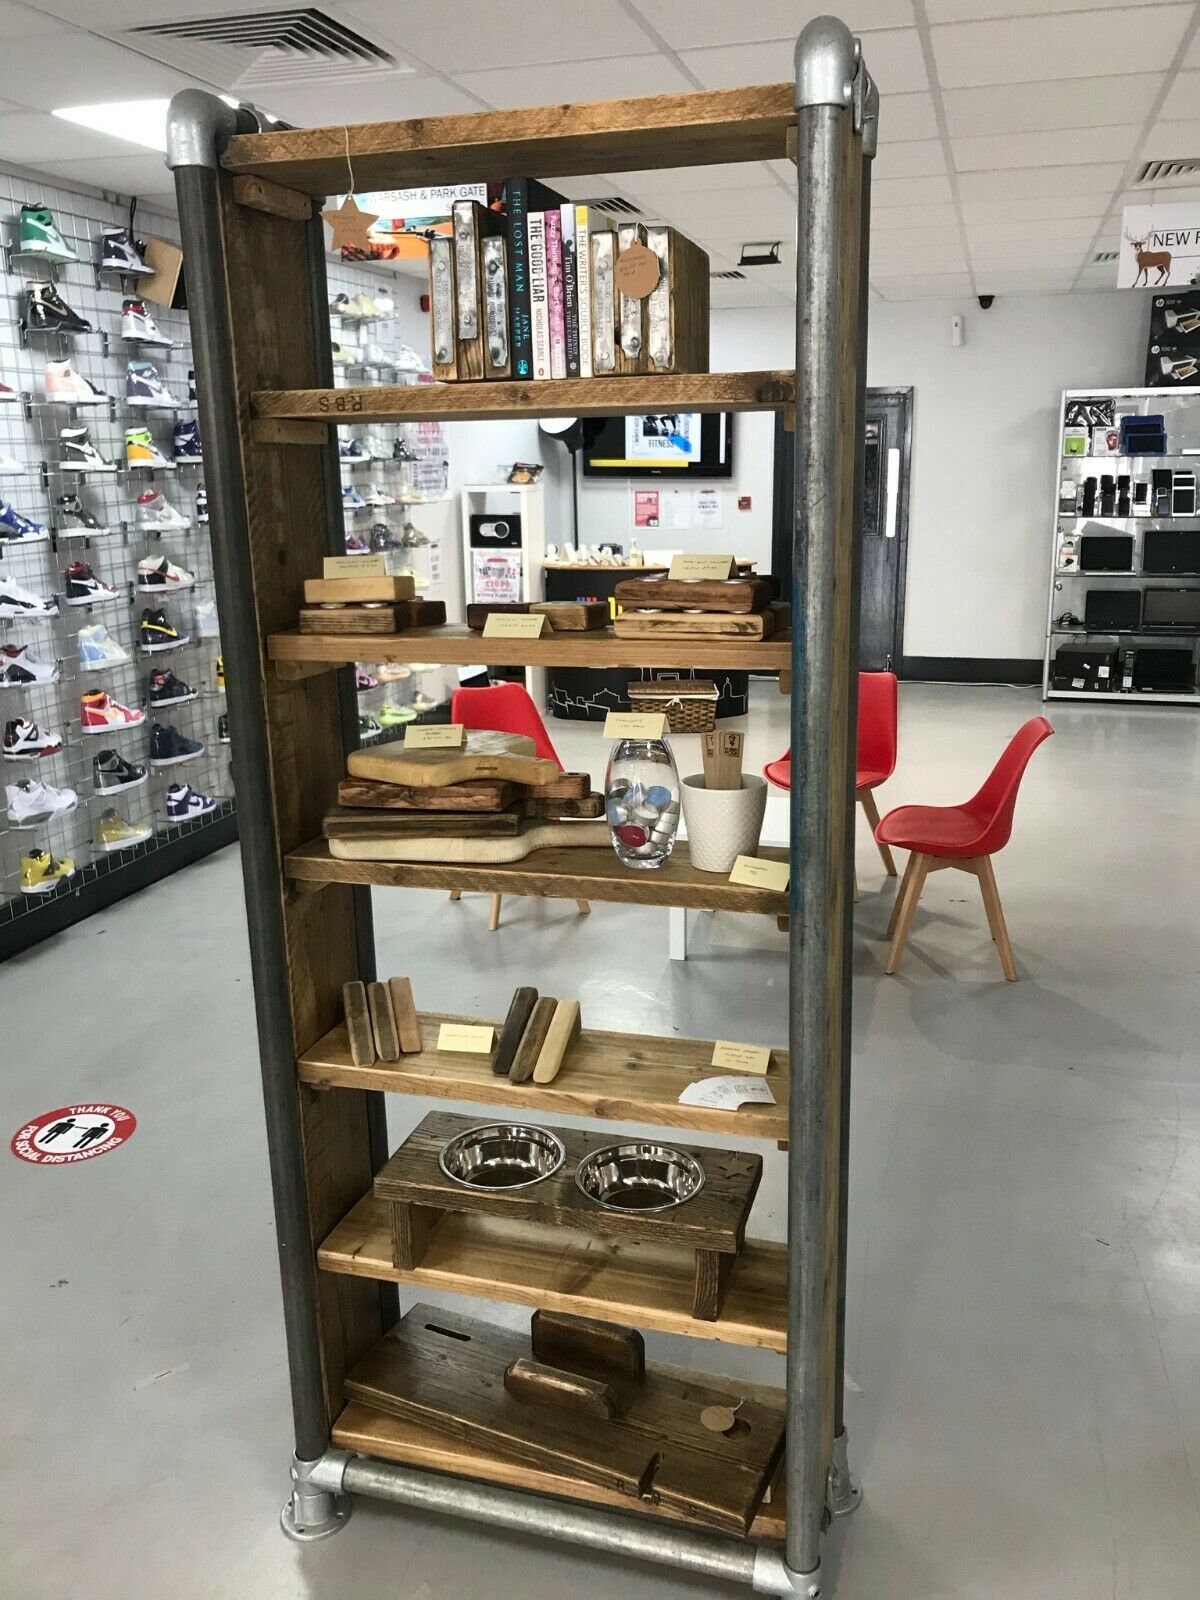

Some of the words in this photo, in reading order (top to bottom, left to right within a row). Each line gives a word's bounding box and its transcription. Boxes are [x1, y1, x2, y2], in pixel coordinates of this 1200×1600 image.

[420, 189, 428, 200] &
[430, 187, 458, 199] PARK
[459, 185, 485, 197] GATE
[512, 191, 522, 215] THE
[513, 222, 523, 255] LOST
[529, 218, 542, 241] THE
[578, 230, 587, 248] THE
[1153, 231, 1191, 247] NEW
[530, 243, 544, 275] GOOD
[565, 255, 573, 273] Tim
[515, 263, 525, 292] MAN
[579, 251, 588, 294] WRITER'S
[532, 278, 545, 303] LIAR
[565, 275, 575, 308] O'Brien
[514, 306, 522, 348] HARPER
[521, 314, 530, 340] JANE
[536, 308, 544, 338] NICHOLAS
[580, 297, 588, 334] SOURCE
[581, 340, 589, 366] BOOK
[648, 439, 675, 449] FITNESS
[69, 1105, 113, 1115] THANK
[109, 1109, 131, 1122] YOU
[16, 1125, 39, 1140] FOR
[15, 1140, 43, 1162] SOCIAL
[40, 1137, 123, 1163] DISTANCING
